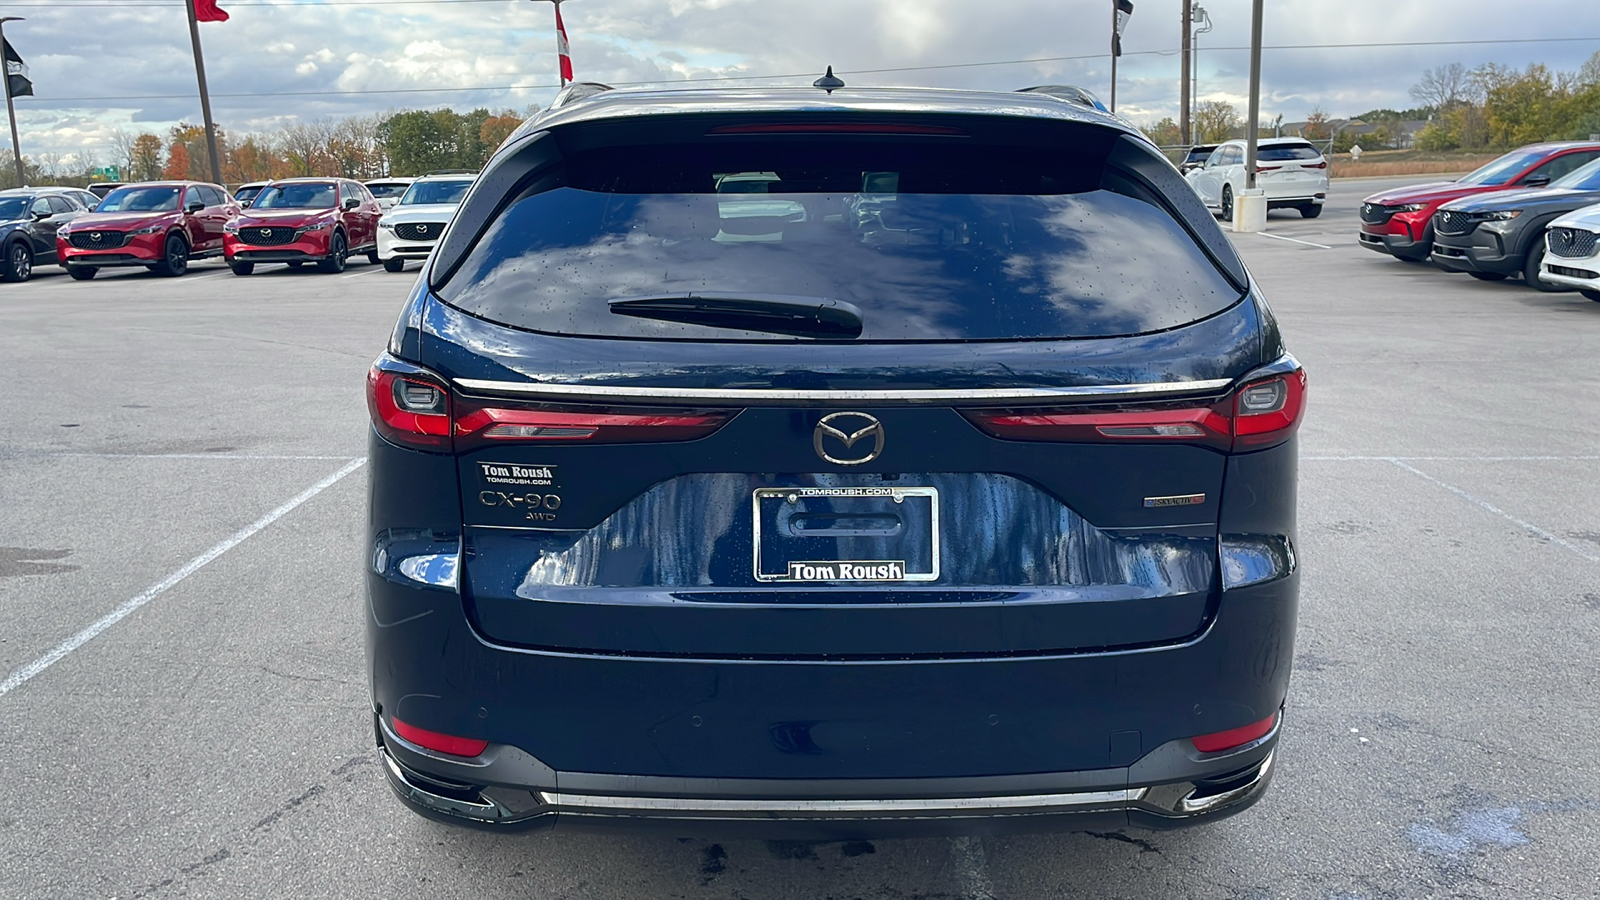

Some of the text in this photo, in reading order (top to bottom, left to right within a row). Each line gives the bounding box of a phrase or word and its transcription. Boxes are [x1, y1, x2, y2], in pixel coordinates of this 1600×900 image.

[481, 465, 553, 478] Tom Roush
[486, 477, 552, 485] TOMROUSH.COM
[800, 488, 892, 496] TOMROUSH.COM
[479, 490, 562, 510] CX-90
[525, 512, 556, 521] AWD
[791, 562, 903, 580] Tom Roush
